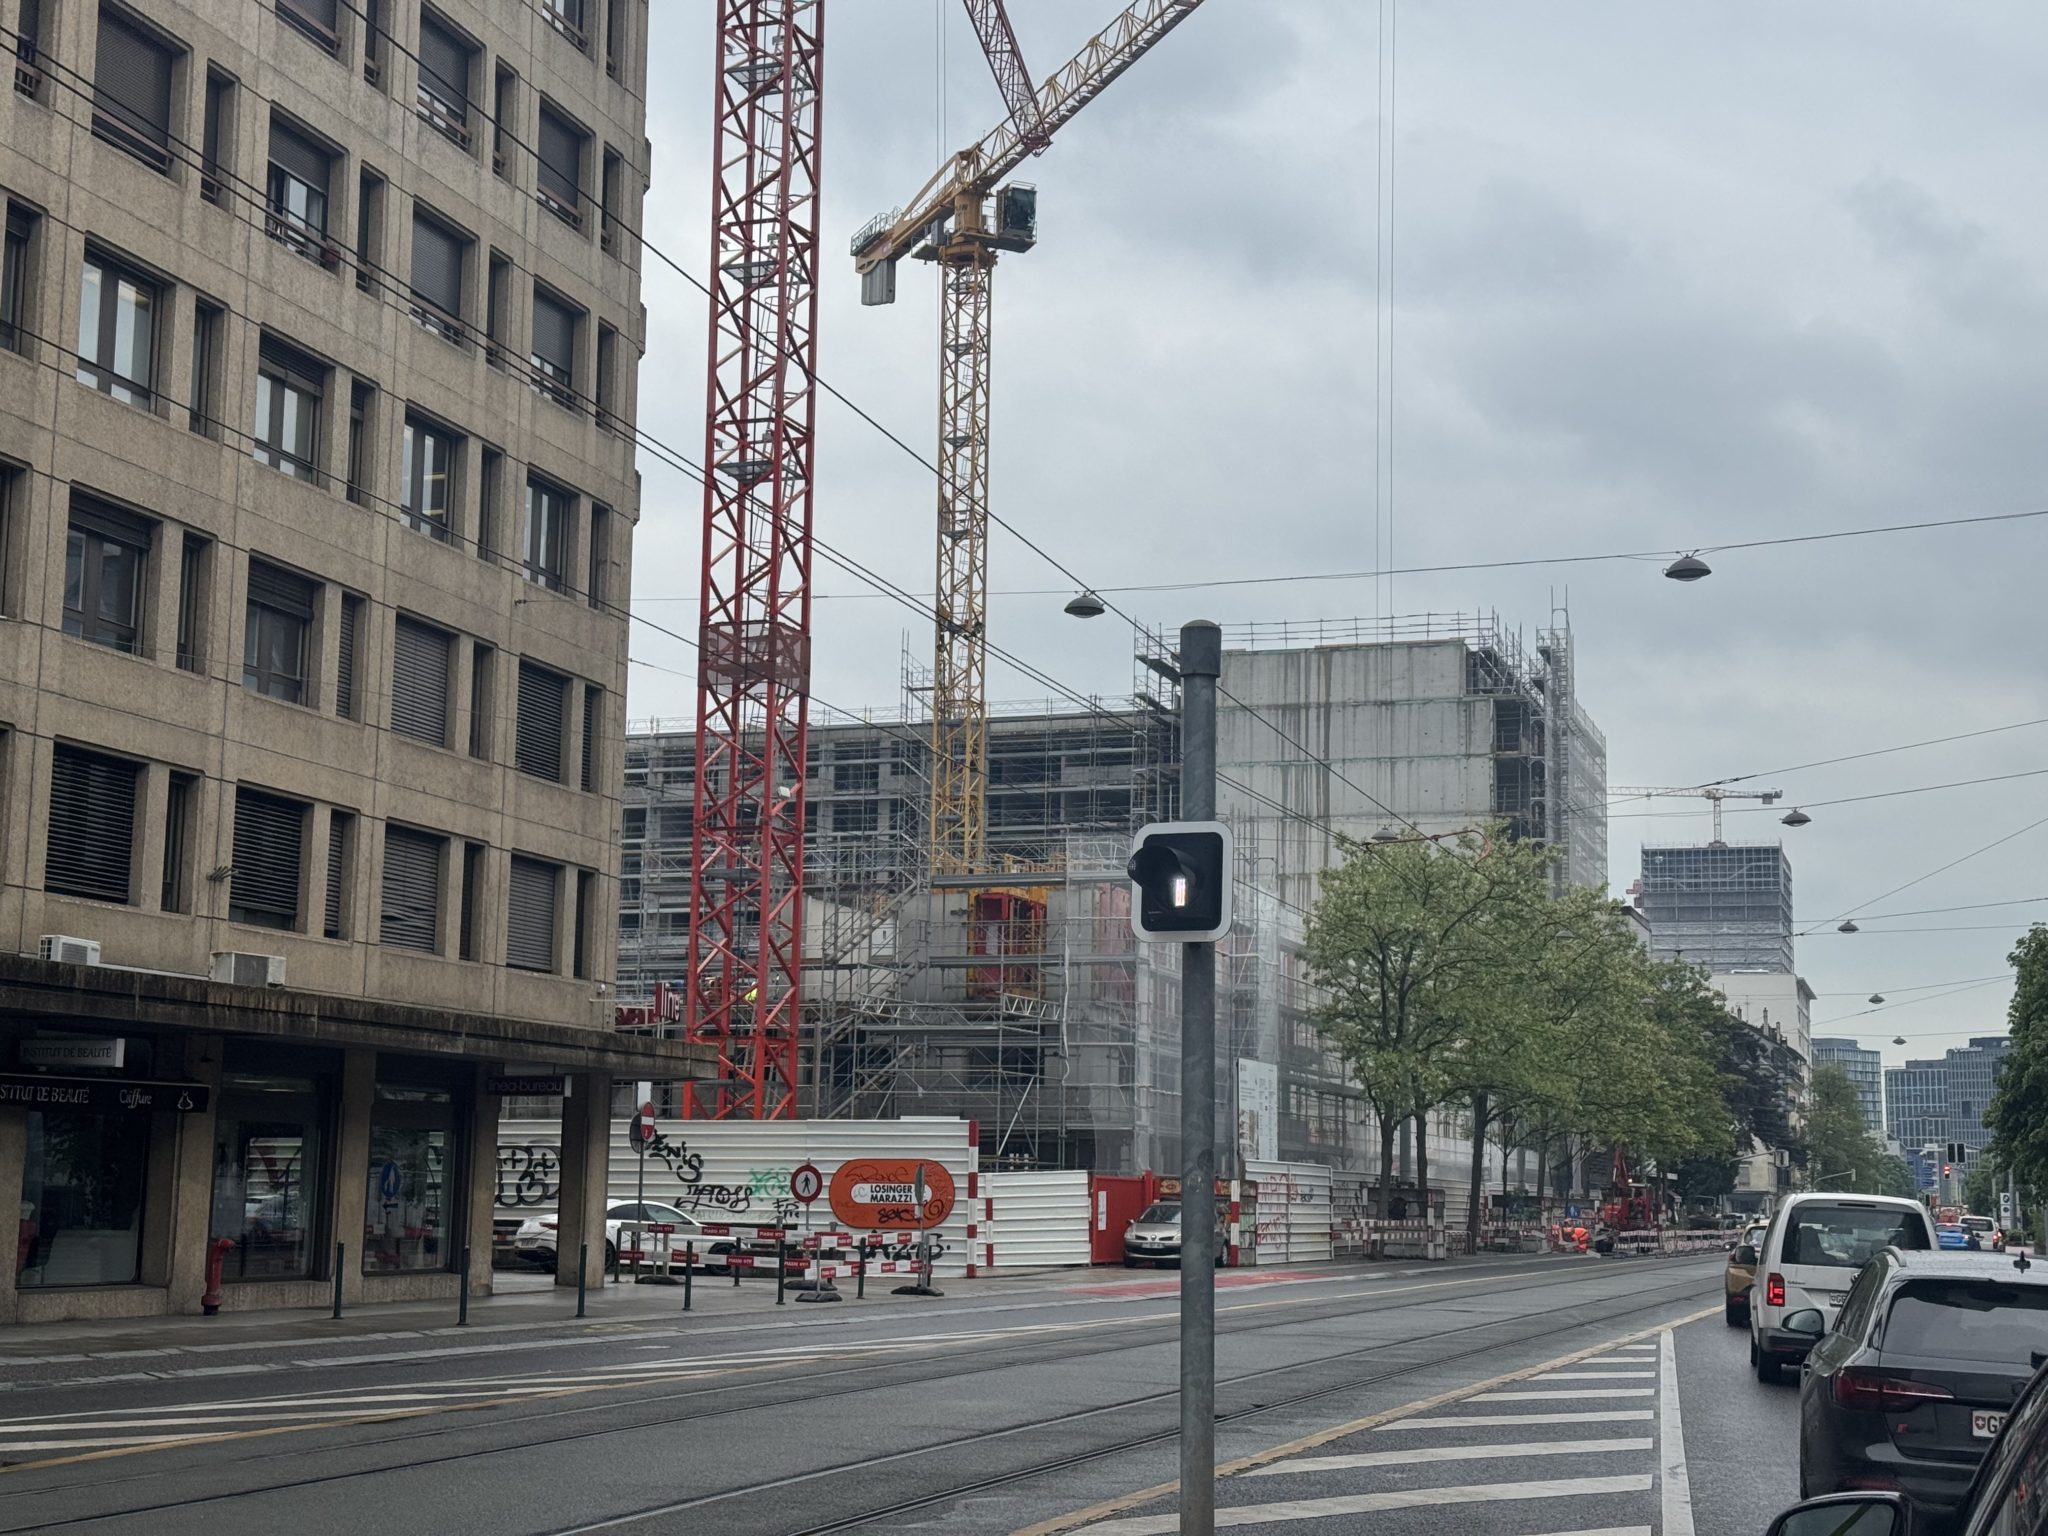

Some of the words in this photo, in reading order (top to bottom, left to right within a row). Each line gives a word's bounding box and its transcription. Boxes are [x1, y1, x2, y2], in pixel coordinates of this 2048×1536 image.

[63, 1047, 76, 1058] DE
[77, 1046, 112, 1058] BEAUTÉ
[37, 1086, 50, 1102] DE
[52, 1086, 90, 1103] BEAUTÉ
[870, 1185, 912, 1193] LOSINGER
[870, 1194, 912, 1203] MARAZZI
